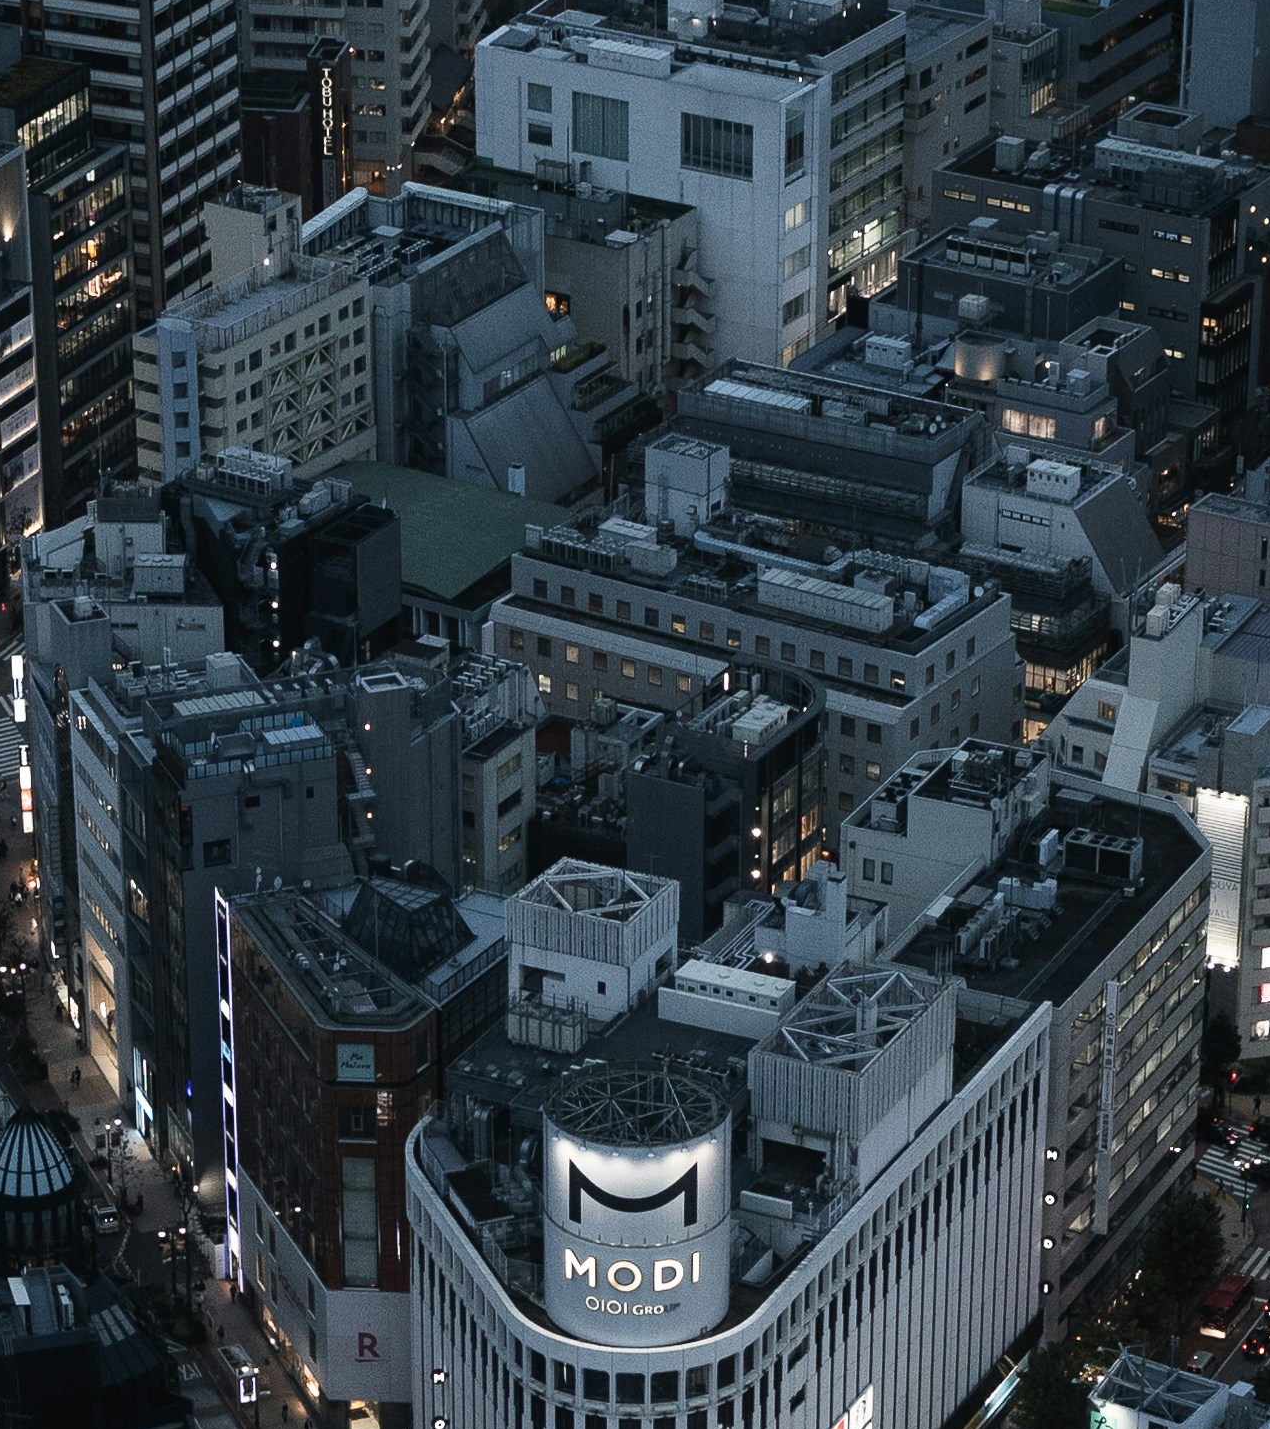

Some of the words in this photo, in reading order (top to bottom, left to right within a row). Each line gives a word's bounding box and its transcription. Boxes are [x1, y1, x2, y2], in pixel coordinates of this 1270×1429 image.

[321, 67, 332, 106] TOBU
[321, 108, 332, 156] HOTEL
[564, 1247, 701, 1293] MODI
